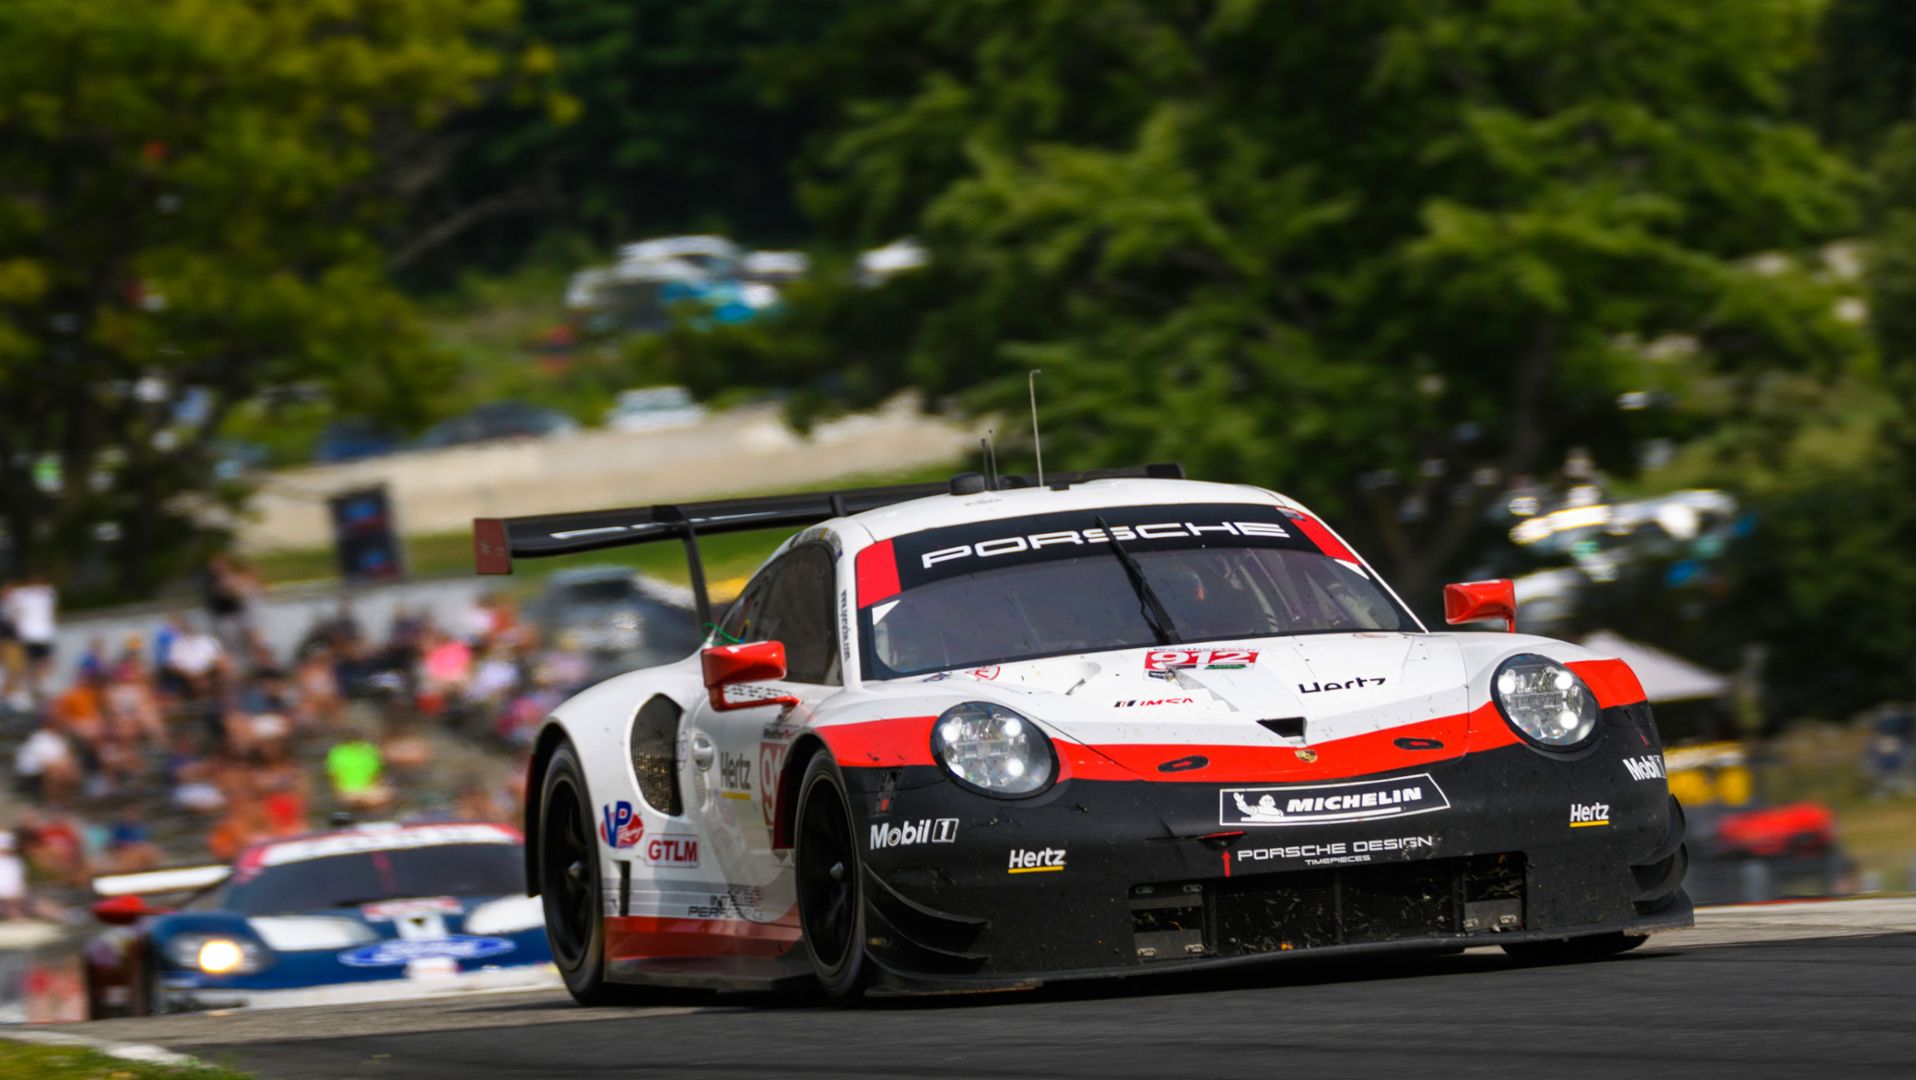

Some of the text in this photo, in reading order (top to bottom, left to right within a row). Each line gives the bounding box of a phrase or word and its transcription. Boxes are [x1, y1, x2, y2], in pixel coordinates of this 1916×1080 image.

[921, 521, 1290, 569] PORSCHE
[1148, 650, 1252, 670] 912
[721, 751, 752, 791] Hertz
[1622, 754, 1661, 781] Mobil
[1286, 786, 1422, 813] MICHELIN
[1570, 801, 1610, 822] Hertz
[603, 800, 633, 848] VP
[869, 819, 931, 850] Mobil
[648, 839, 698, 863] GTLM
[1008, 847, 1067, 869] Hertz
[1237, 835, 1433, 861] PORSCHE DESIGN
[1305, 854, 1372, 866] TIMEPIECES
